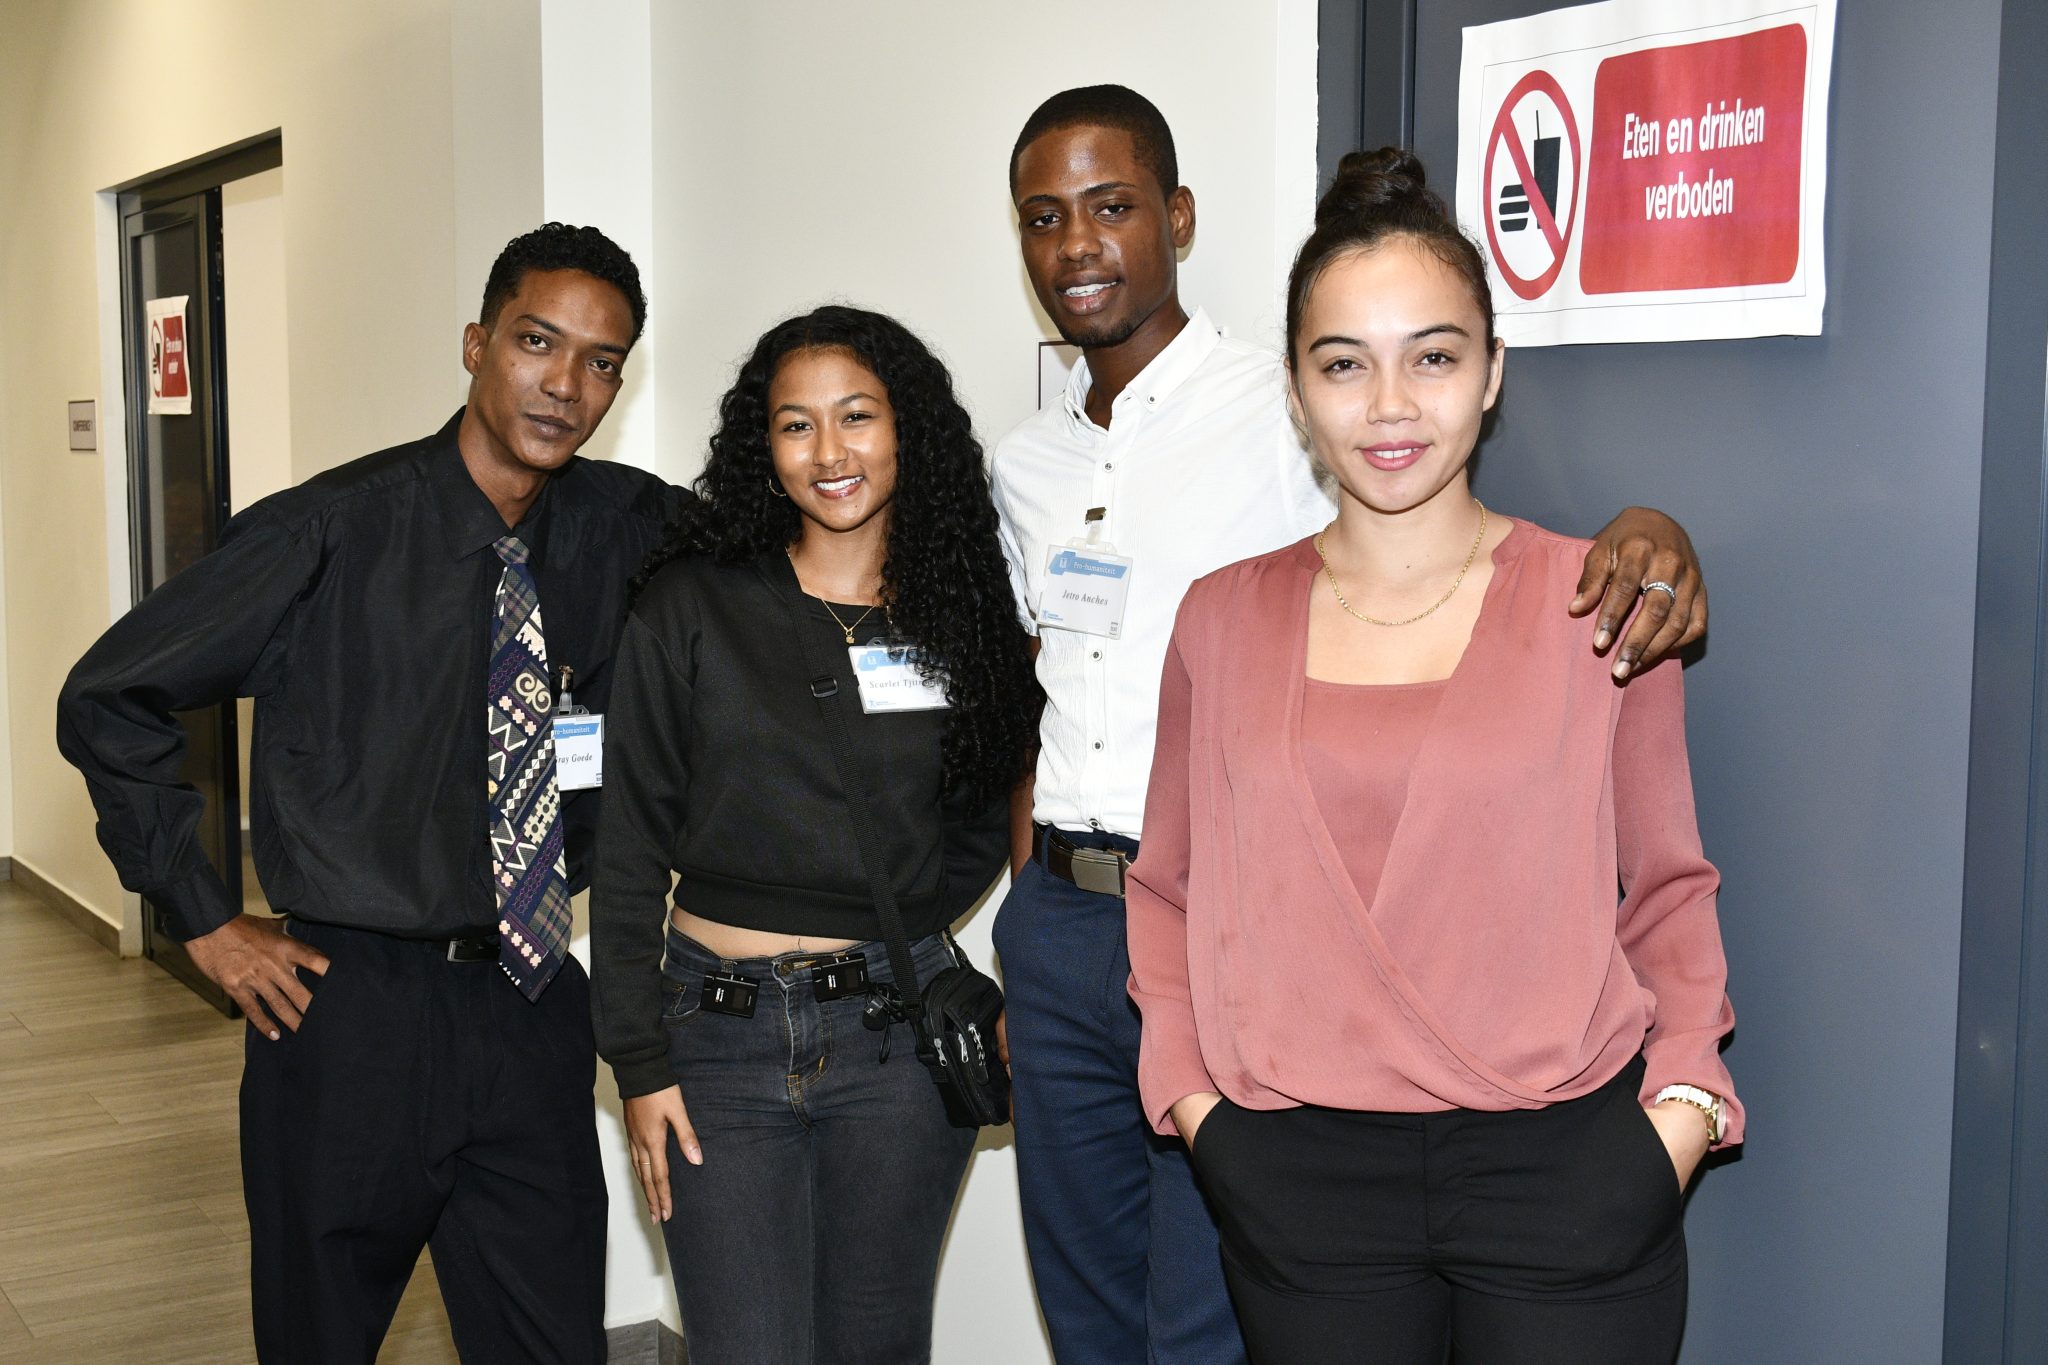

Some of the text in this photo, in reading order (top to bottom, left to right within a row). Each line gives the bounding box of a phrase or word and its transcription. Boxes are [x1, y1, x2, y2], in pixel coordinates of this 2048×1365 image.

[1622, 98, 1765, 160] Eten en drinken
[1645, 168, 1734, 221] verboden
[869, 679, 900, 689] Scarlet
[571, 753, 592, 763] Goede
